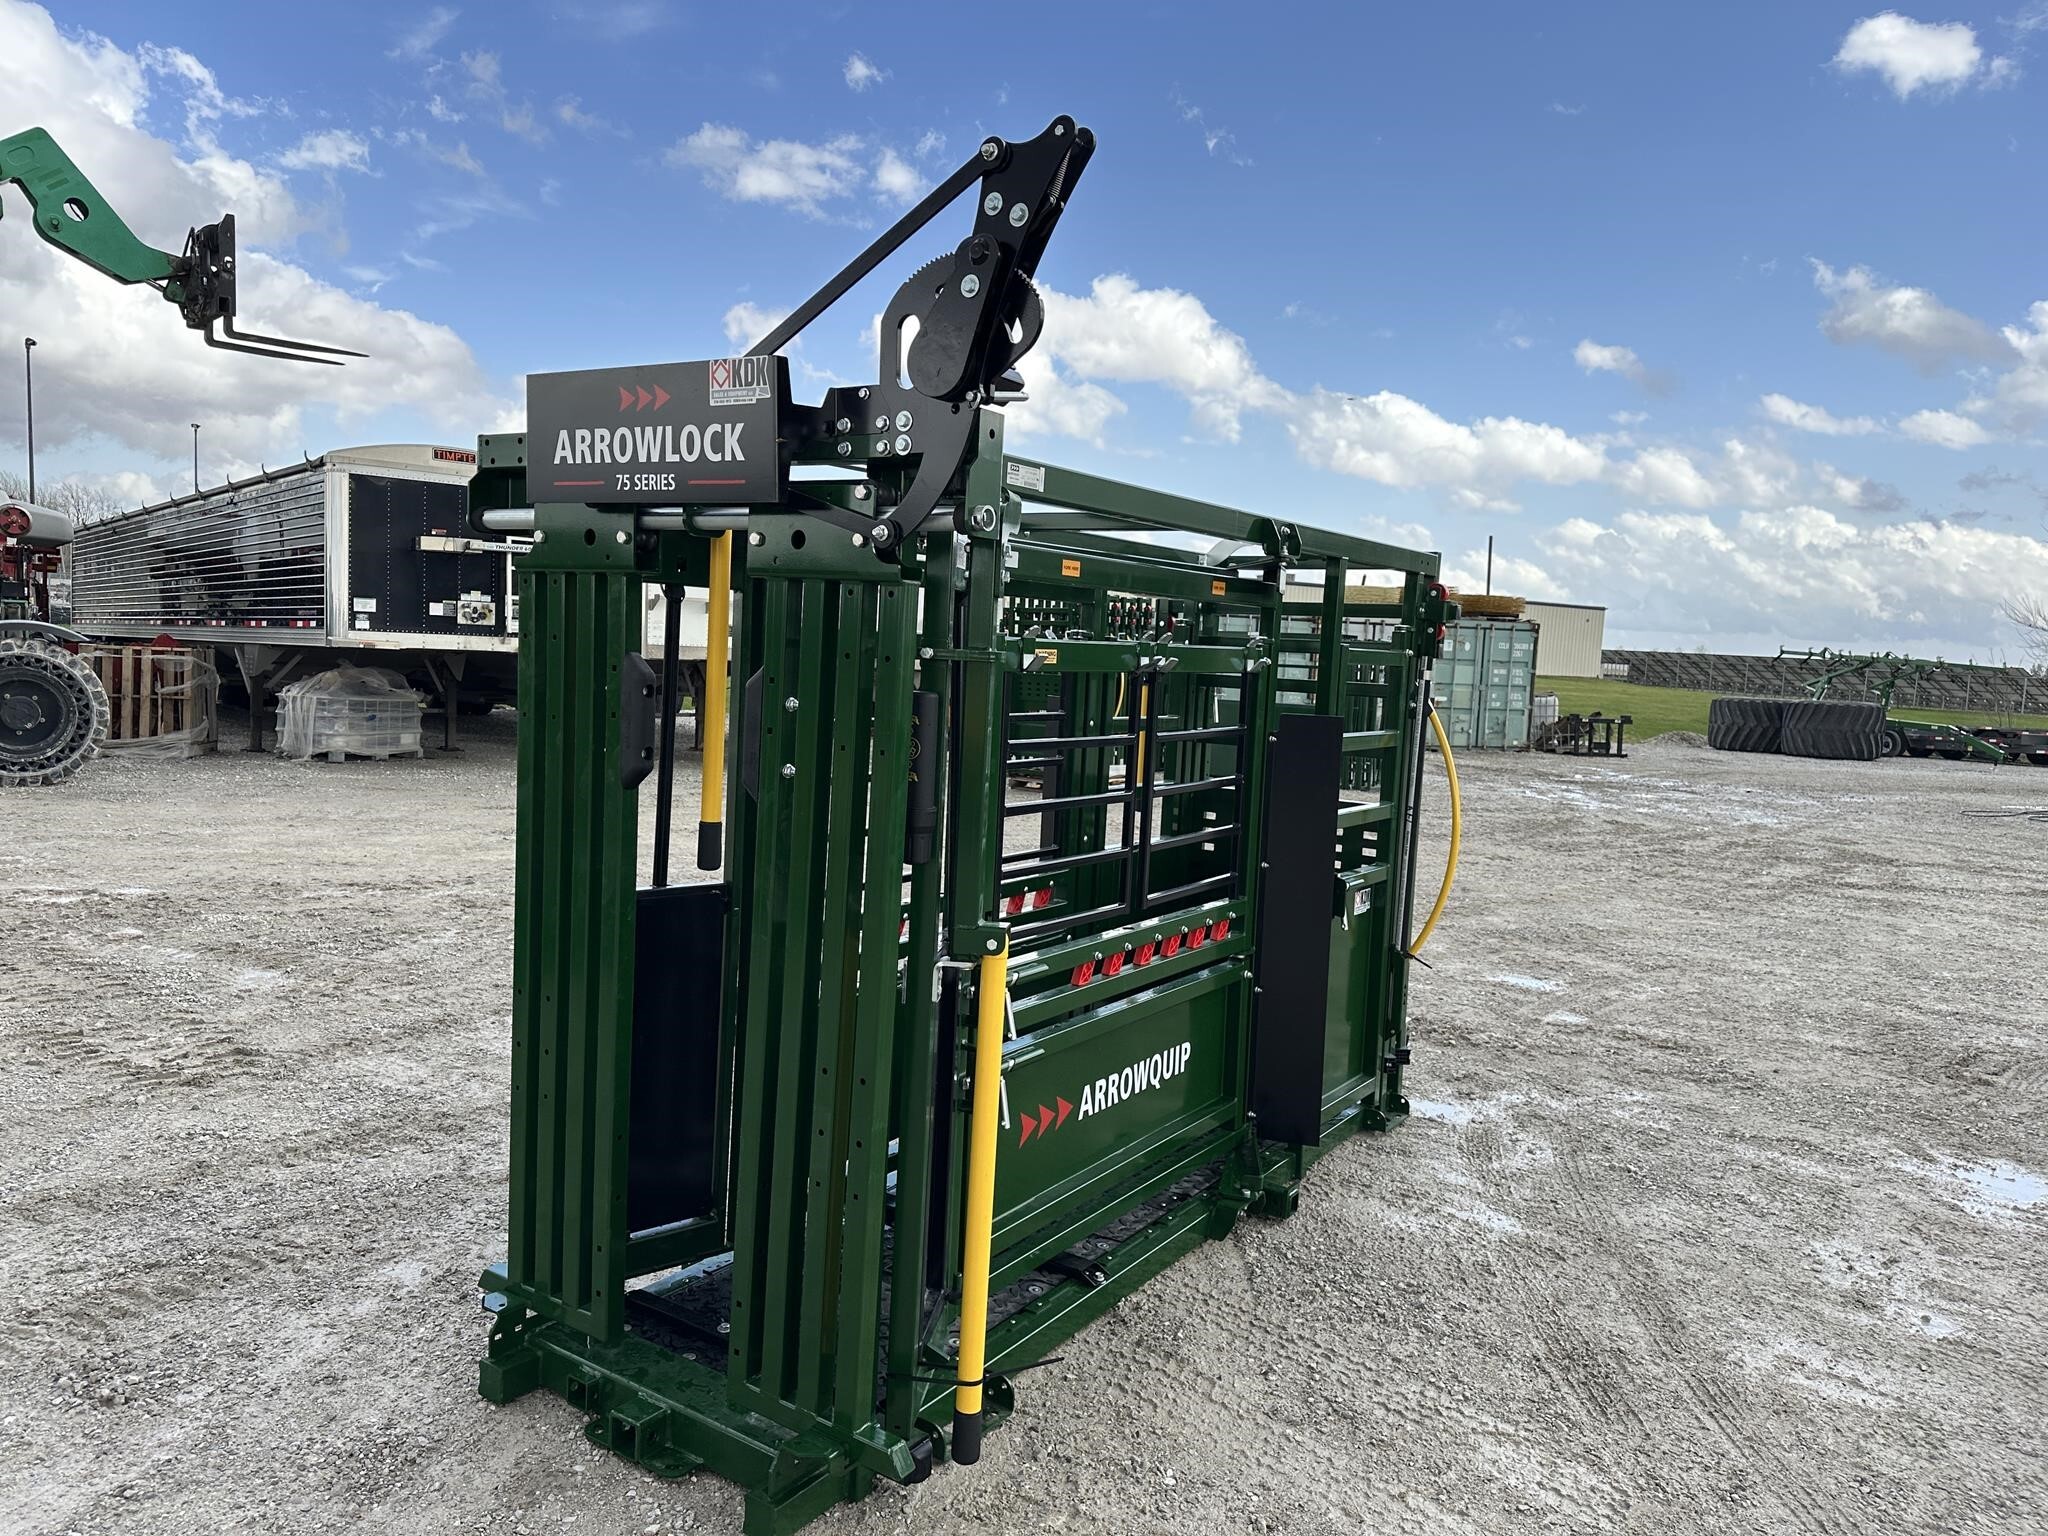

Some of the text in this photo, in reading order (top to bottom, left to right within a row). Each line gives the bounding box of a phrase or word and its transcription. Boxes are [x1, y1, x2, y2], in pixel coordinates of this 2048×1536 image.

[731, 357, 768, 388] KDK
[553, 422, 746, 465] ARROWLOCK
[435, 450, 475, 463] TIMPTE
[615, 473, 676, 491] 75 SERIES
[495, 544, 524, 552] THUNDER
[1078, 1041, 1191, 1121] ARROWQUIP
